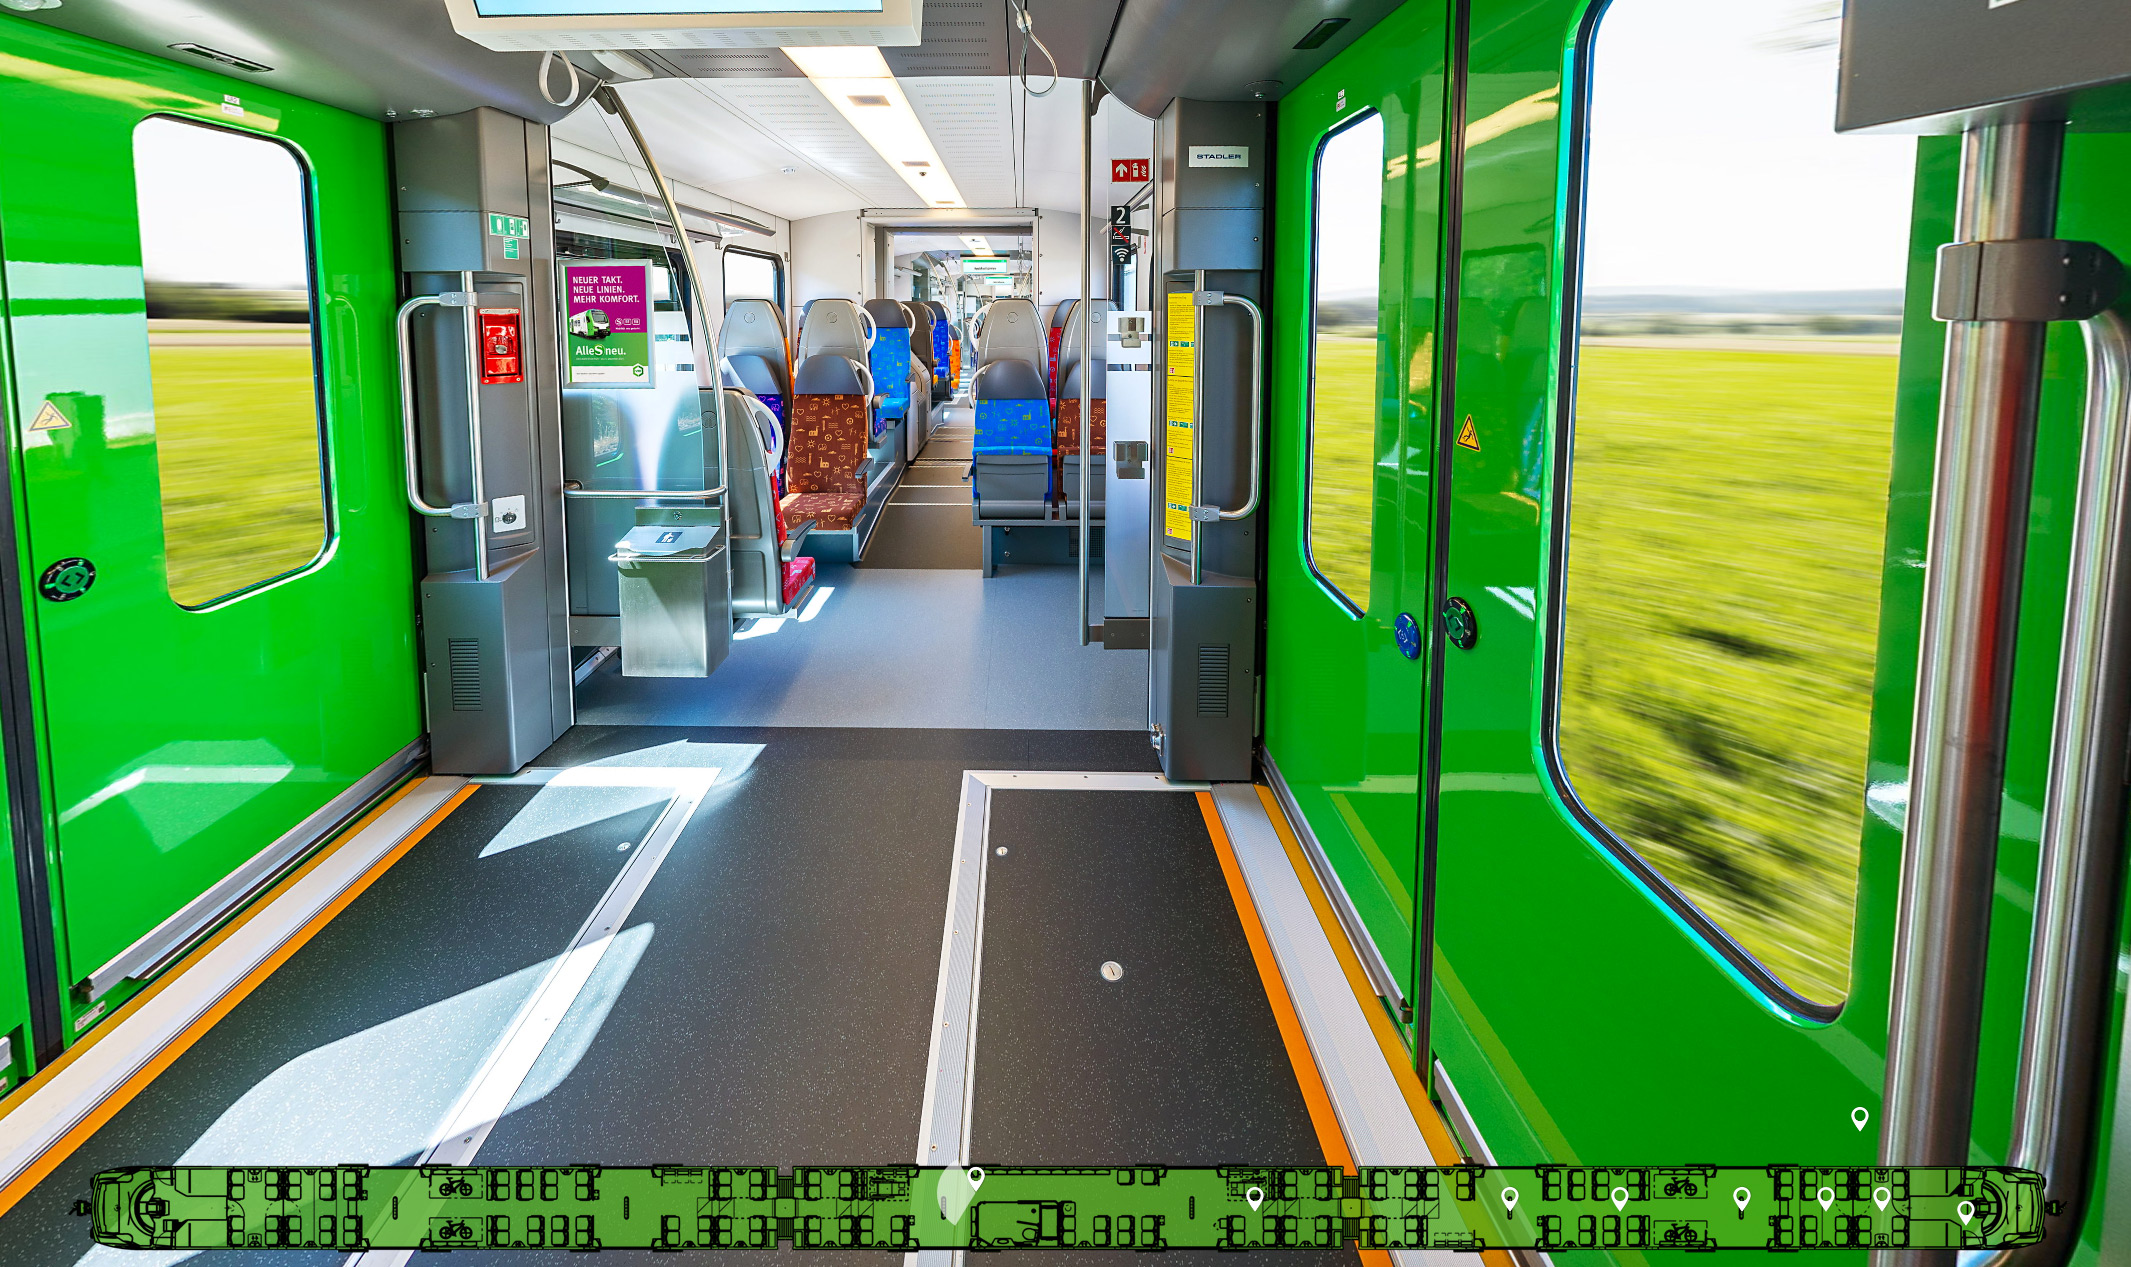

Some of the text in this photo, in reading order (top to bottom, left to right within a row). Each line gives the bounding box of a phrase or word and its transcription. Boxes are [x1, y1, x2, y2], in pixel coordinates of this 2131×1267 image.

[1115, 206, 1126, 224] 2
[572, 276, 623, 284] NEUER TAKT.
[573, 286, 625, 294] NEUE LINIEN.
[573, 295, 640, 303] MEHR KOMFORT.
